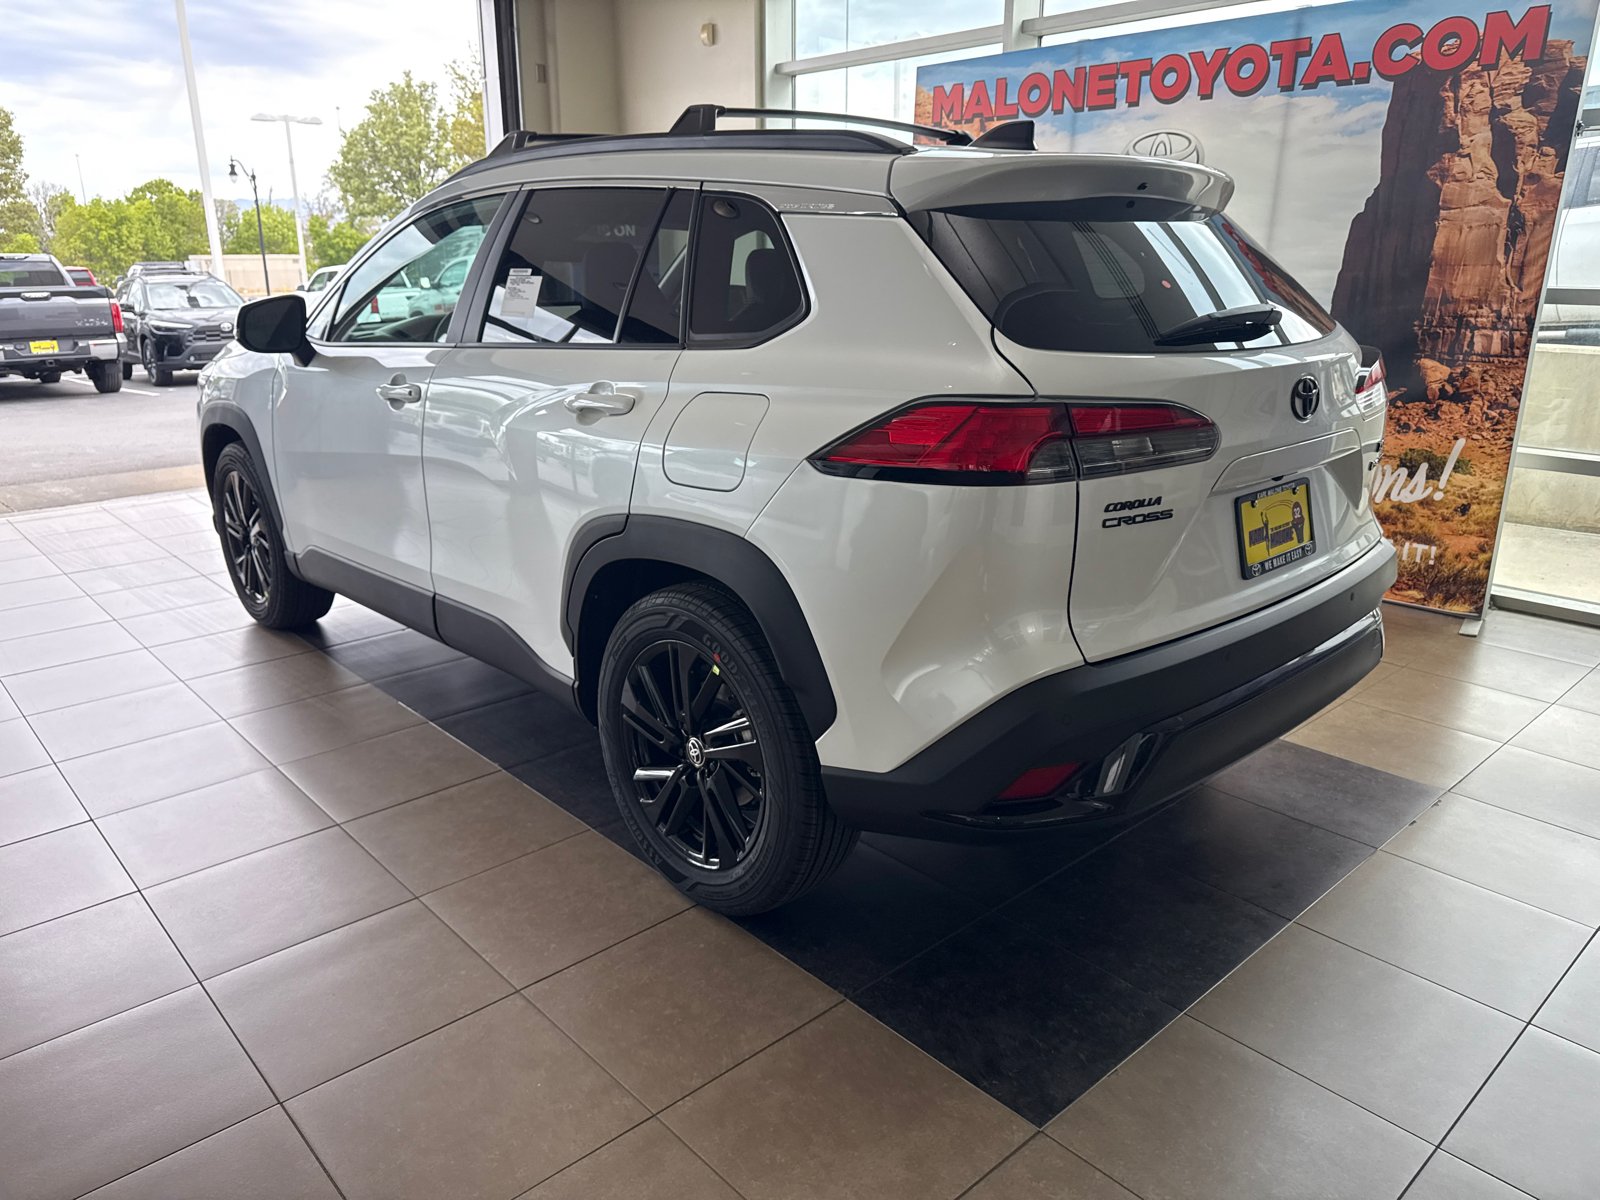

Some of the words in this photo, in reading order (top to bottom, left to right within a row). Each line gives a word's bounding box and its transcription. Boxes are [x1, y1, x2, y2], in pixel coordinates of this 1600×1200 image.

[931, 4, 1553, 126] MALONETOYOTA.COM
[1104, 495, 1163, 513] COROLLA
[1293, 507, 1301, 518] 32
[1102, 508, 1174, 529] CROSS
[1264, 560, 1273, 571] WE
[1273, 554, 1286, 568] MAKE
[1286, 551, 1292, 563] IT
[1291, 547, 1303, 561] EASY
[1401, 541, 1437, 565] IT!
